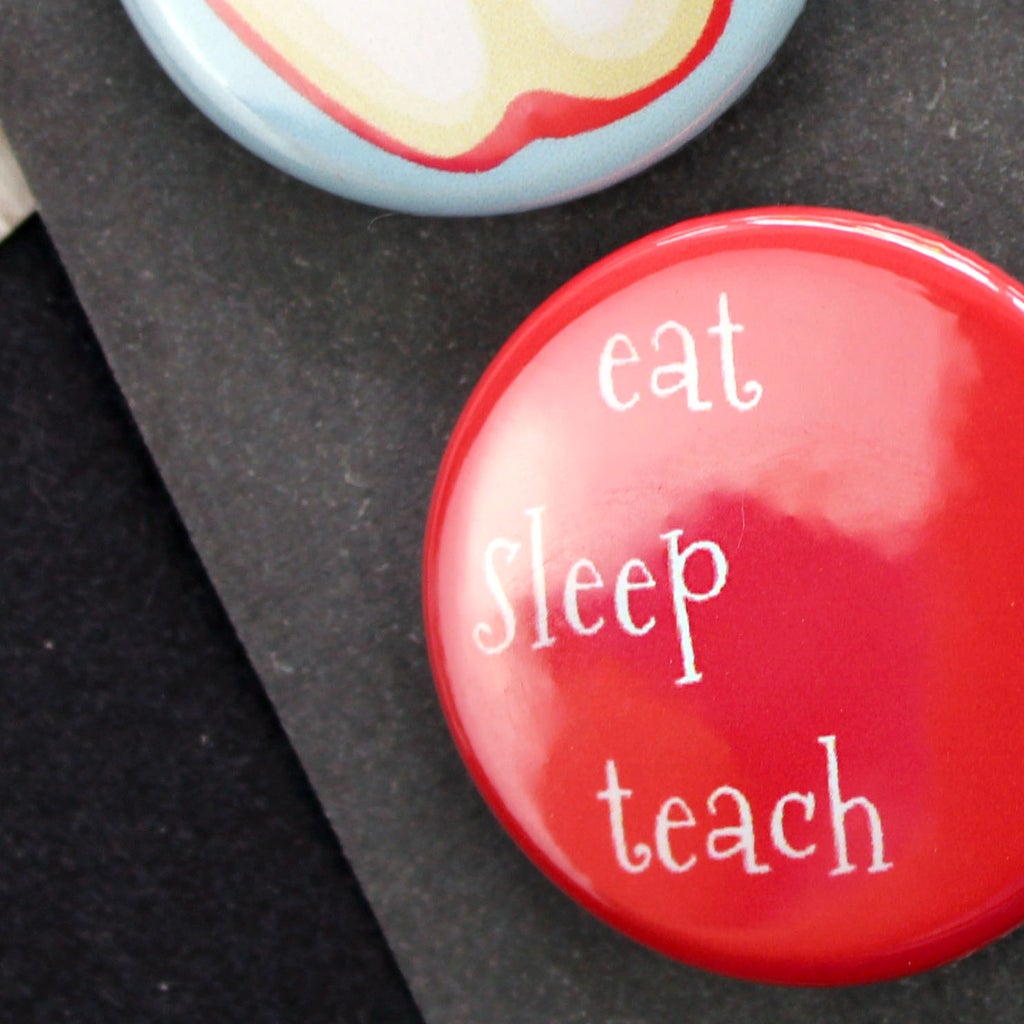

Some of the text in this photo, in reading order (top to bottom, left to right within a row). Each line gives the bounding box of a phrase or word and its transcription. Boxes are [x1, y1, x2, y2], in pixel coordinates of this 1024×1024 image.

[598, 291, 763, 411] eat
[473, 506, 729, 685] sleep
[597, 736, 894, 876] teach
